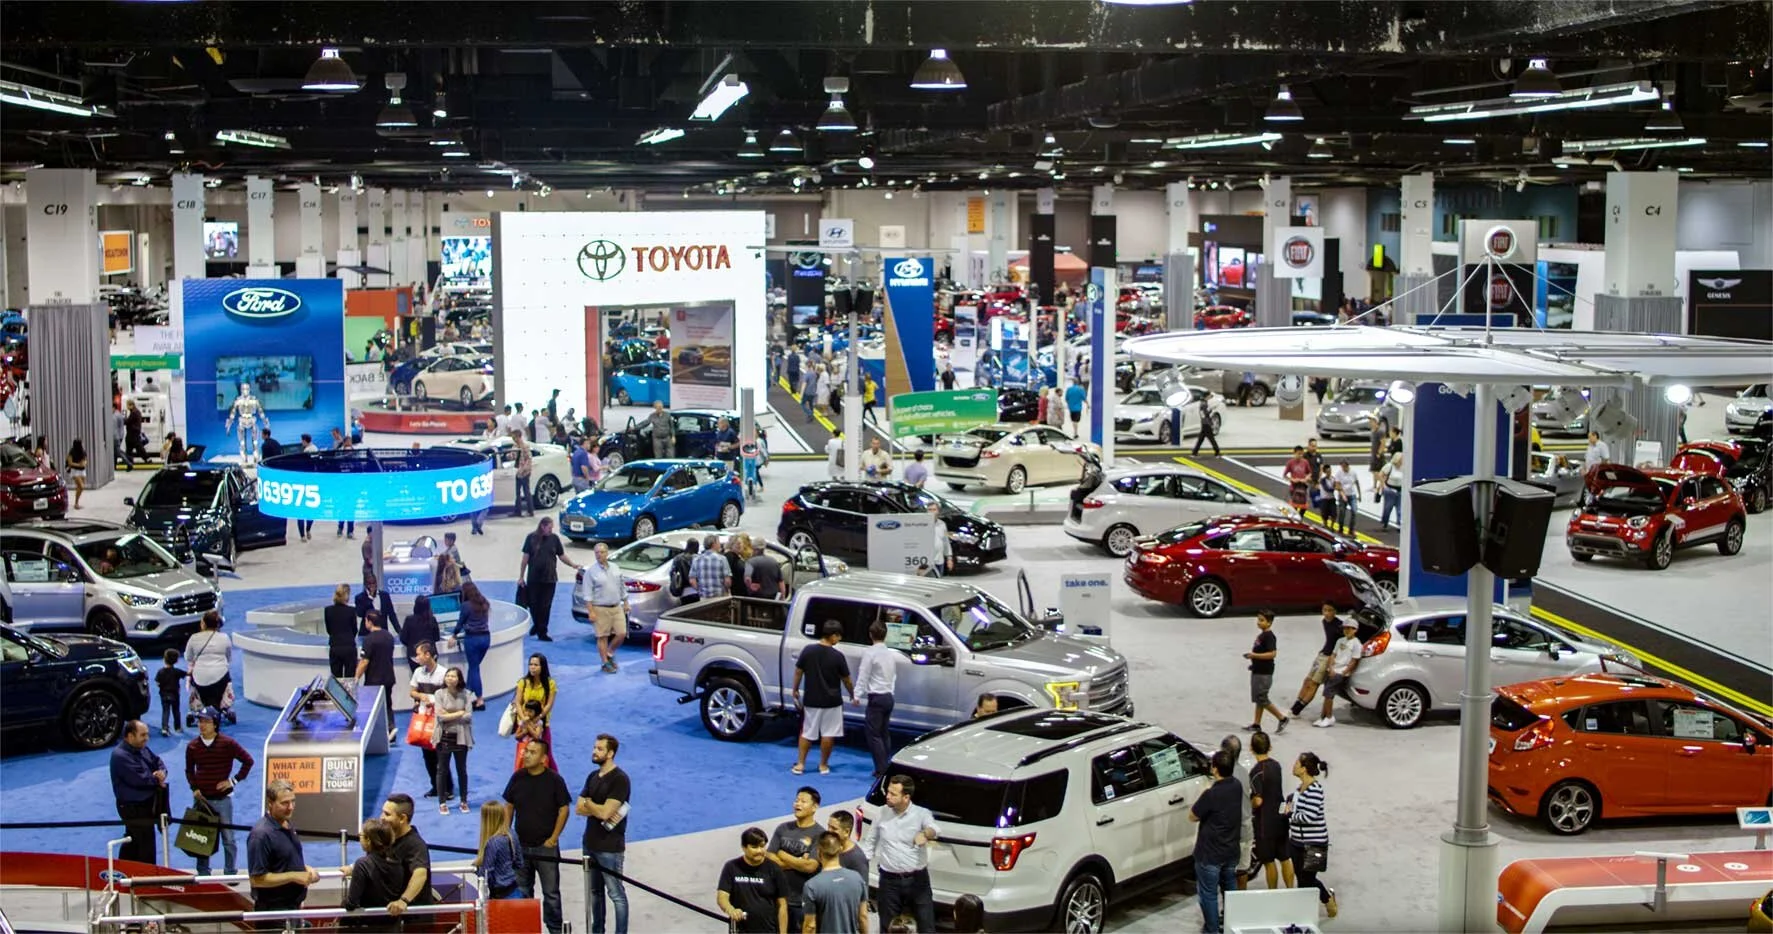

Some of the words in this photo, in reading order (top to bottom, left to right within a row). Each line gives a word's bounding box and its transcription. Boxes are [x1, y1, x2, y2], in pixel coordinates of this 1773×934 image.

[250, 191, 267, 200] C17
[177, 200, 196, 209] C18
[1414, 200, 1427, 208] C5
[44, 204, 68, 215] C19
[1645, 206, 1661, 216] C4
[1494, 236, 1509, 249] FIAT
[1289, 245, 1308, 260] FIAT
[631, 245, 731, 272] TOYOTA
[237, 289, 285, 312] Ford
[436, 478, 467, 505] TO
[470, 471, 494, 499] 639
[263, 480, 321, 508] 63975
[904, 556, 928, 567] 360
[387, 577, 418, 586] COLOR
[1065, 579, 1086, 587] take
[387, 585, 413, 593] YOUR
[272, 762, 297, 770] WHAT
[327, 760, 354, 770] BUILT
[272, 771, 290, 779] YOU
[299, 780, 315, 789] OF?
[327, 780, 353, 788] TOUGH
[186, 829, 209, 845] Jeep
